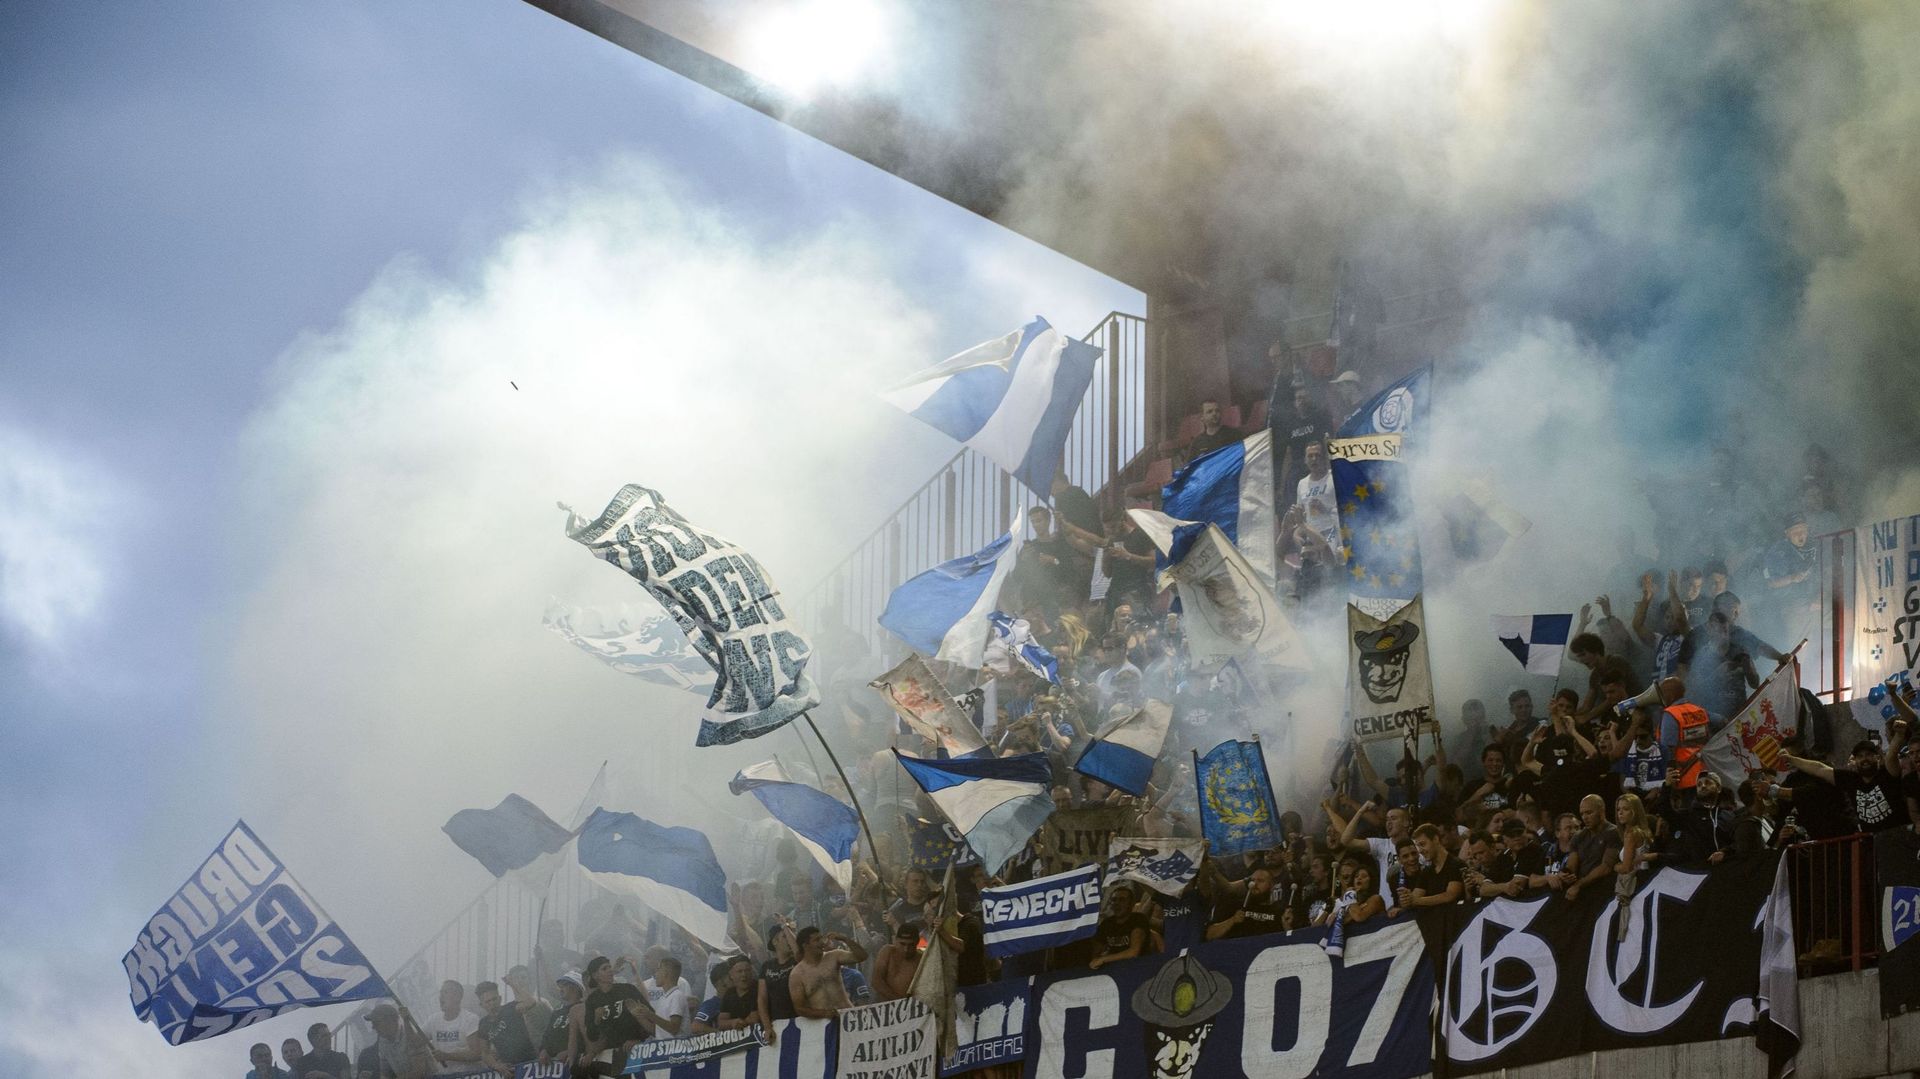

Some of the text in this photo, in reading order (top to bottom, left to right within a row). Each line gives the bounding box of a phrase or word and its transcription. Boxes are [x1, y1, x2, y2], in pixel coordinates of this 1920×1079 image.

[843, 996, 932, 1033] GENECH
[1241, 920, 1426, 1079] 07
[630, 1042, 656, 1060] STOP
[851, 1028, 924, 1063] ALTIJD
